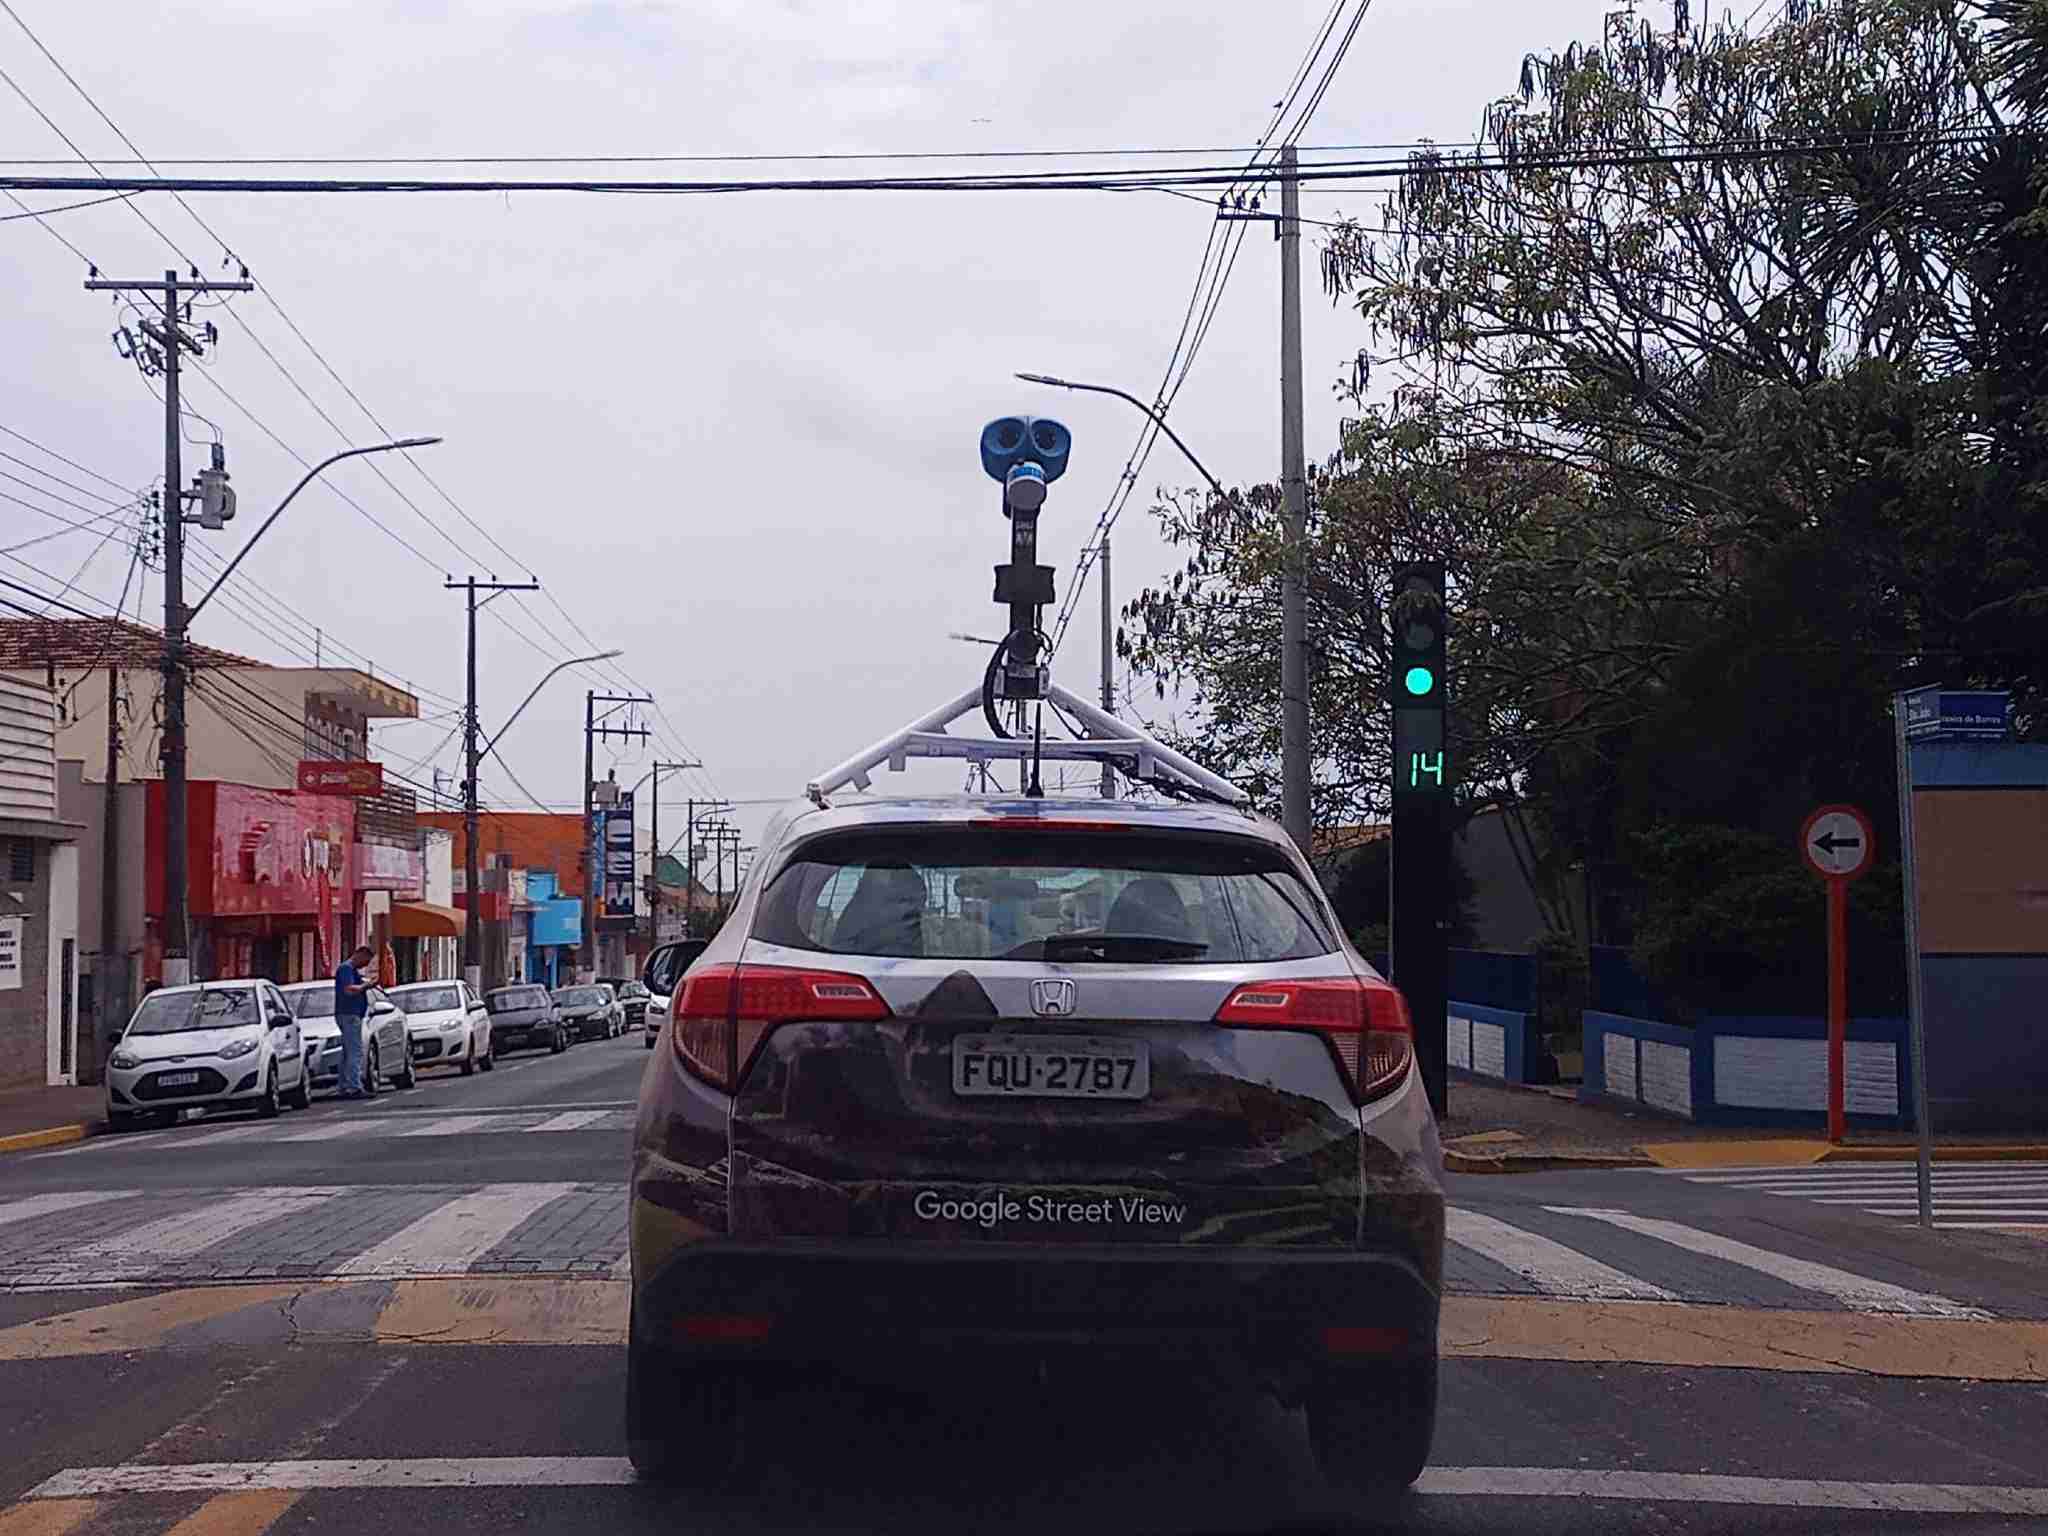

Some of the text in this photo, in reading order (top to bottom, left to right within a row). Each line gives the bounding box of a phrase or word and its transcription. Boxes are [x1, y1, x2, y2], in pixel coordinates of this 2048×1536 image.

[1409, 751, 1444, 787] 14
[914, 1189, 1187, 1228] Google Street View
